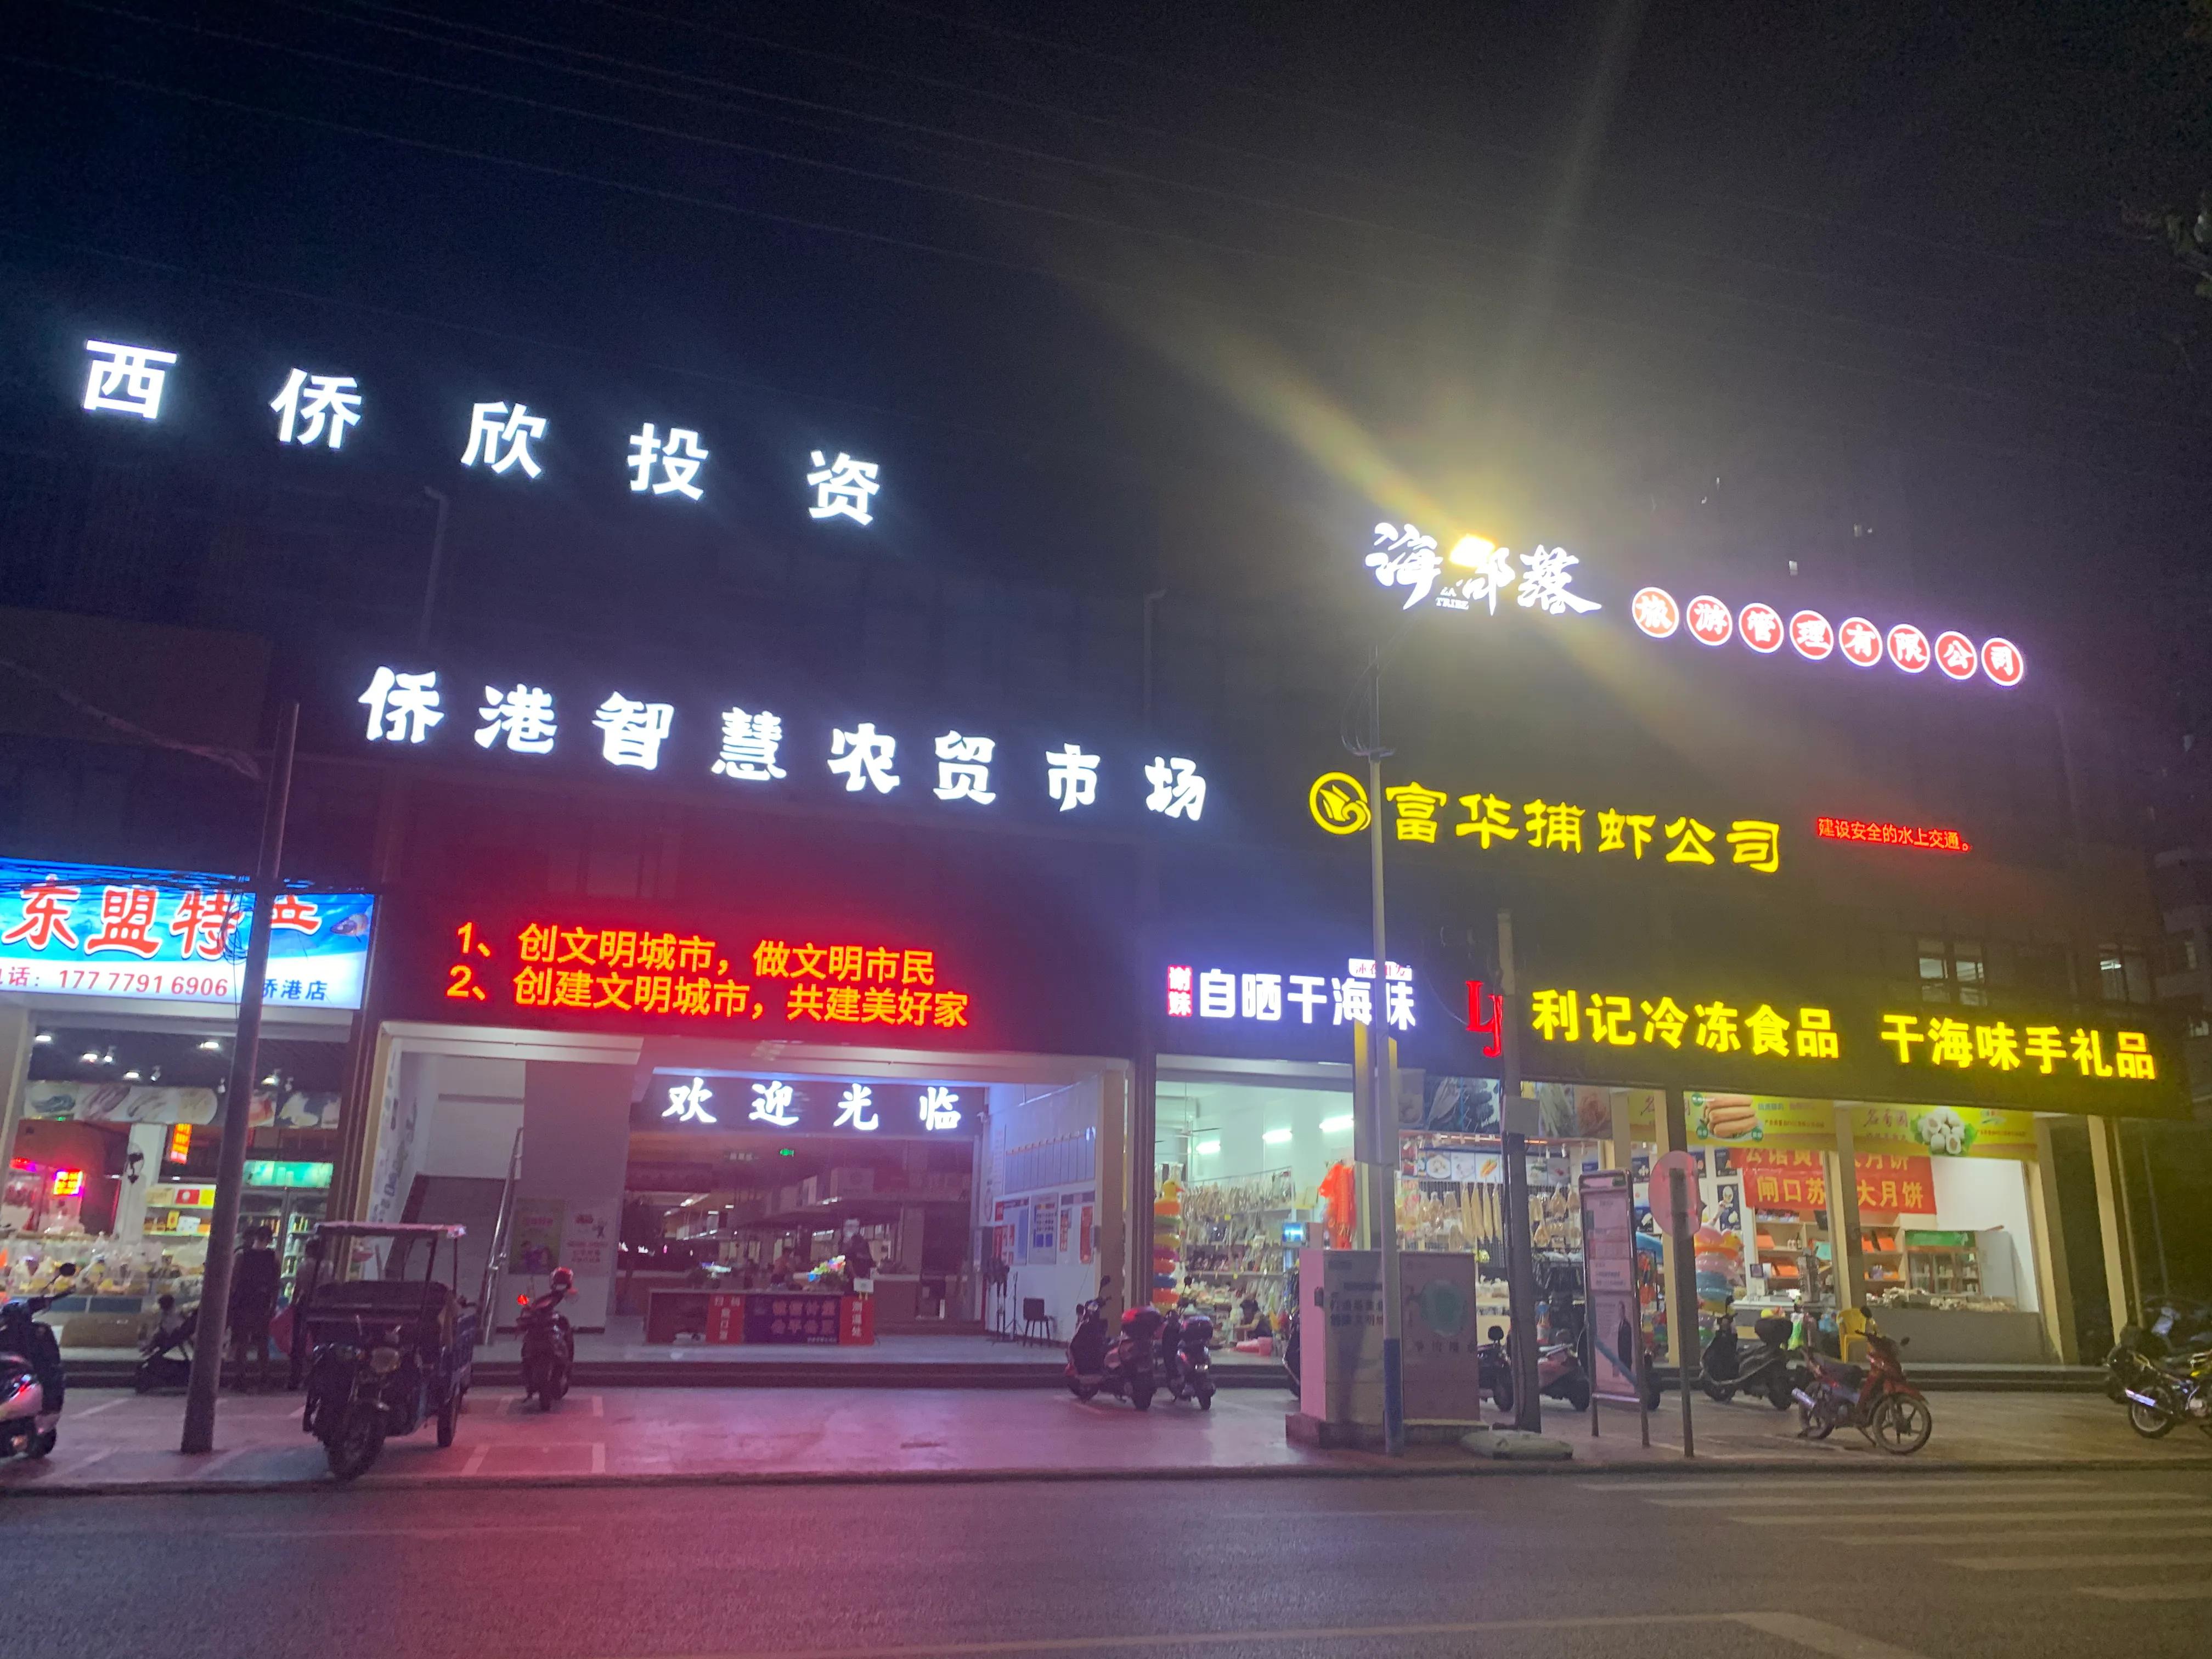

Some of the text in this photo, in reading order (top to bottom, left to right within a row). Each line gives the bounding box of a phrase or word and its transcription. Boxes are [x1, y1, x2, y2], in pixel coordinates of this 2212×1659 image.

[83, 339, 881, 526] 西侨欣投资
[1633, 588, 2023, 686] 旅游管理有限公司
[358, 665, 1207, 822] 侨港智慧农贸市场
[1385, 781, 1780, 873] 富华捕虾公司
[1818, 817, 1969, 851] 建设安全的水上交通。
[0, 966, 41, 988] 话：
[59, 970, 100, 991] 177
[108, 973, 162, 994] 7791
[171, 977, 228, 997] 6906
[1199, 968, 1416, 1030] 自晒干海味
[1532, 989, 2156, 1080] 利记冷冻食品 干海味手礼品
[662, 1077, 961, 1131] 欢迎光临
[1757, 1176, 1923, 1209] 闸口苏大月饼
